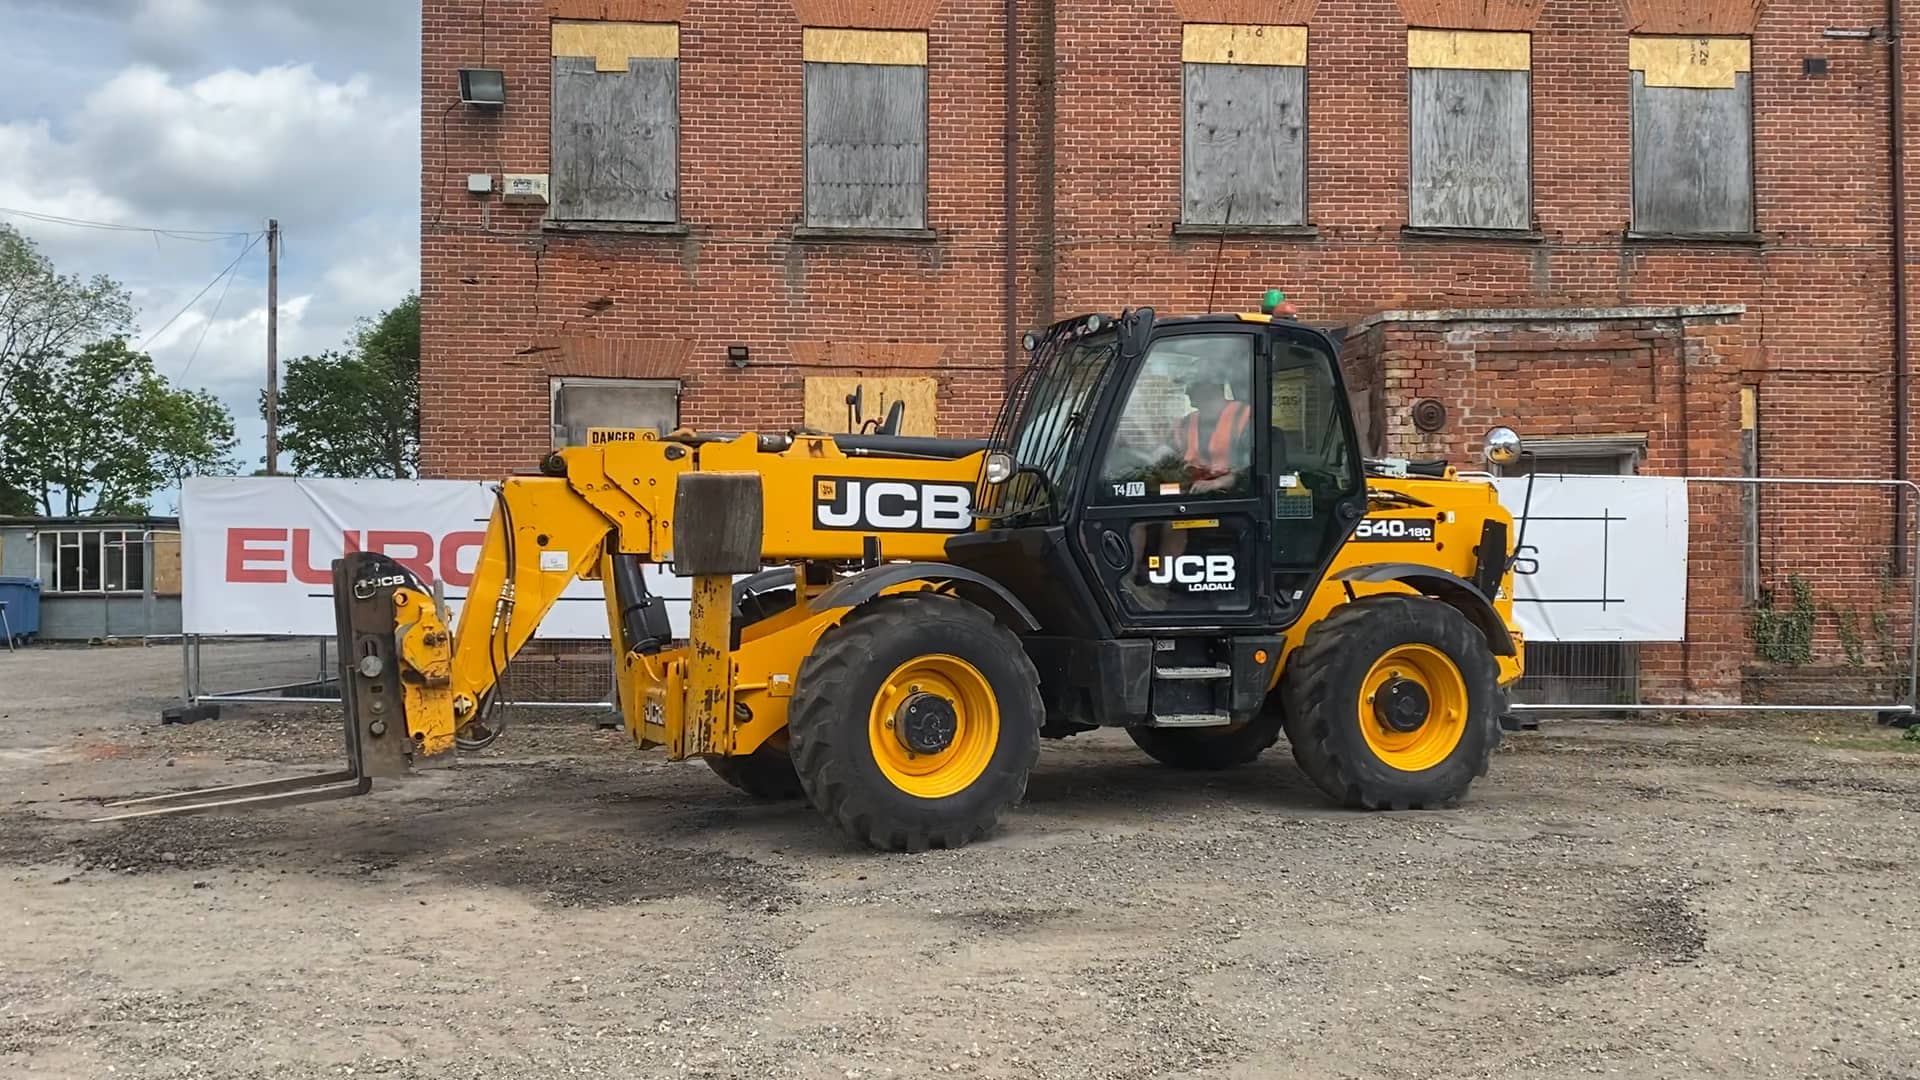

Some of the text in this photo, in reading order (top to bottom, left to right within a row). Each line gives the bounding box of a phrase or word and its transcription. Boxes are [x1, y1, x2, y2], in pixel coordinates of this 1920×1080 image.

[592, 431, 636, 444] DANGER
[818, 481, 973, 530] JCB
[1148, 555, 1236, 584] JCB
[1188, 583, 1235, 592] LOADALL
